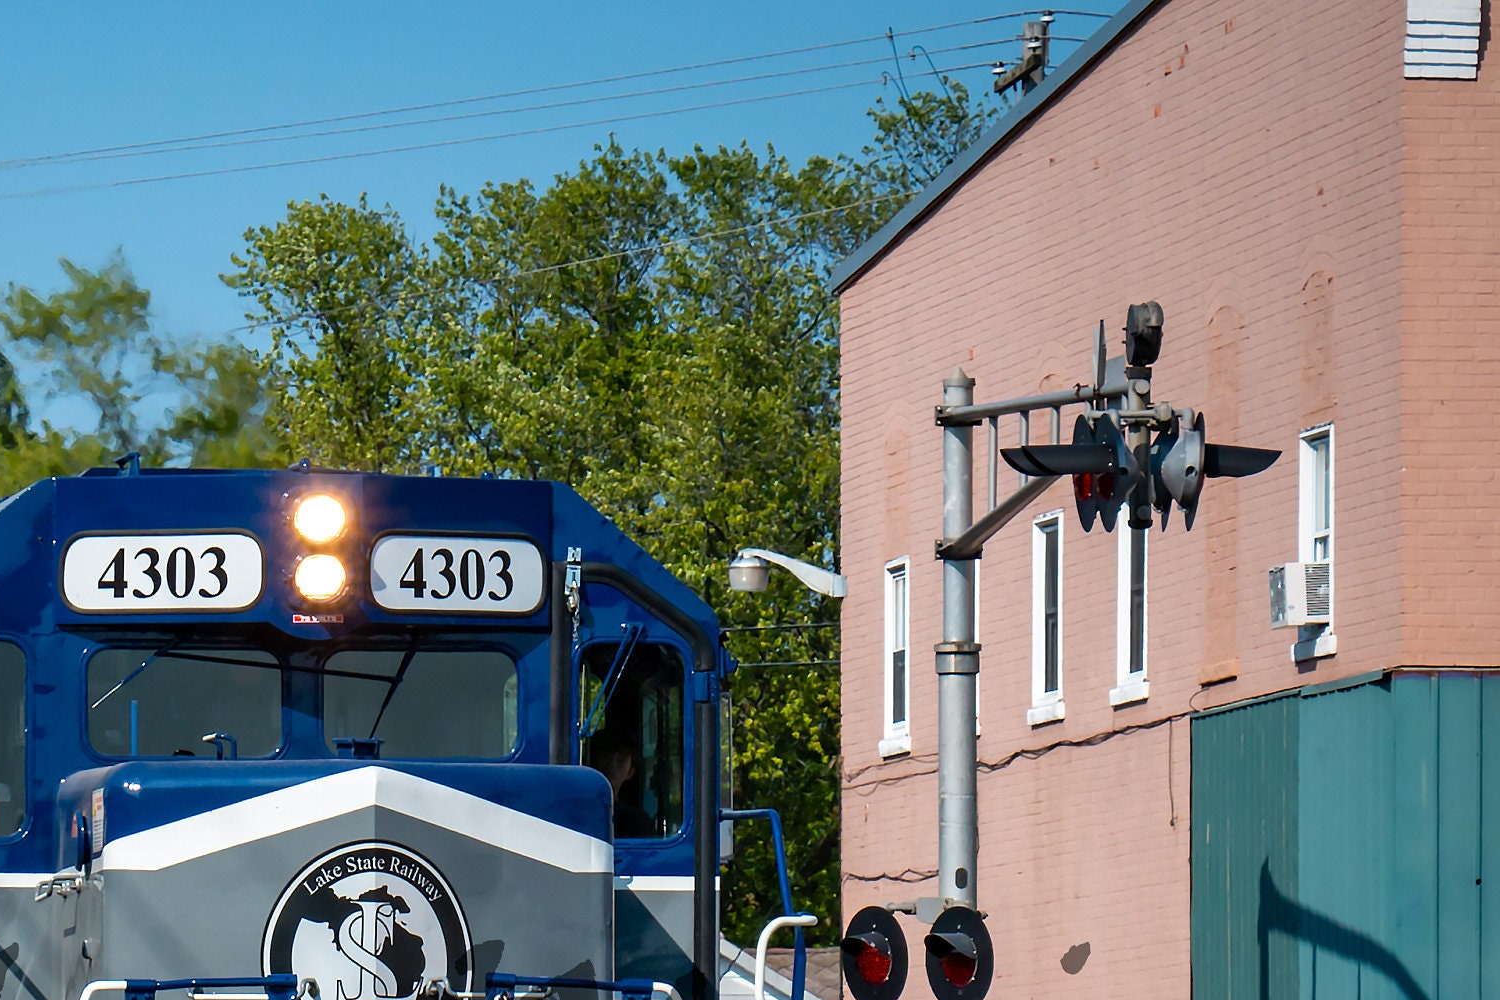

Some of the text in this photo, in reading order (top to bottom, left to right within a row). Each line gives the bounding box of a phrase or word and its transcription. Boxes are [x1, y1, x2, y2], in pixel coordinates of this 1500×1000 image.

[97, 546, 229, 599] 4303
[399, 547, 515, 602] 4303
[303, 856, 442, 901] Lake State Railway
